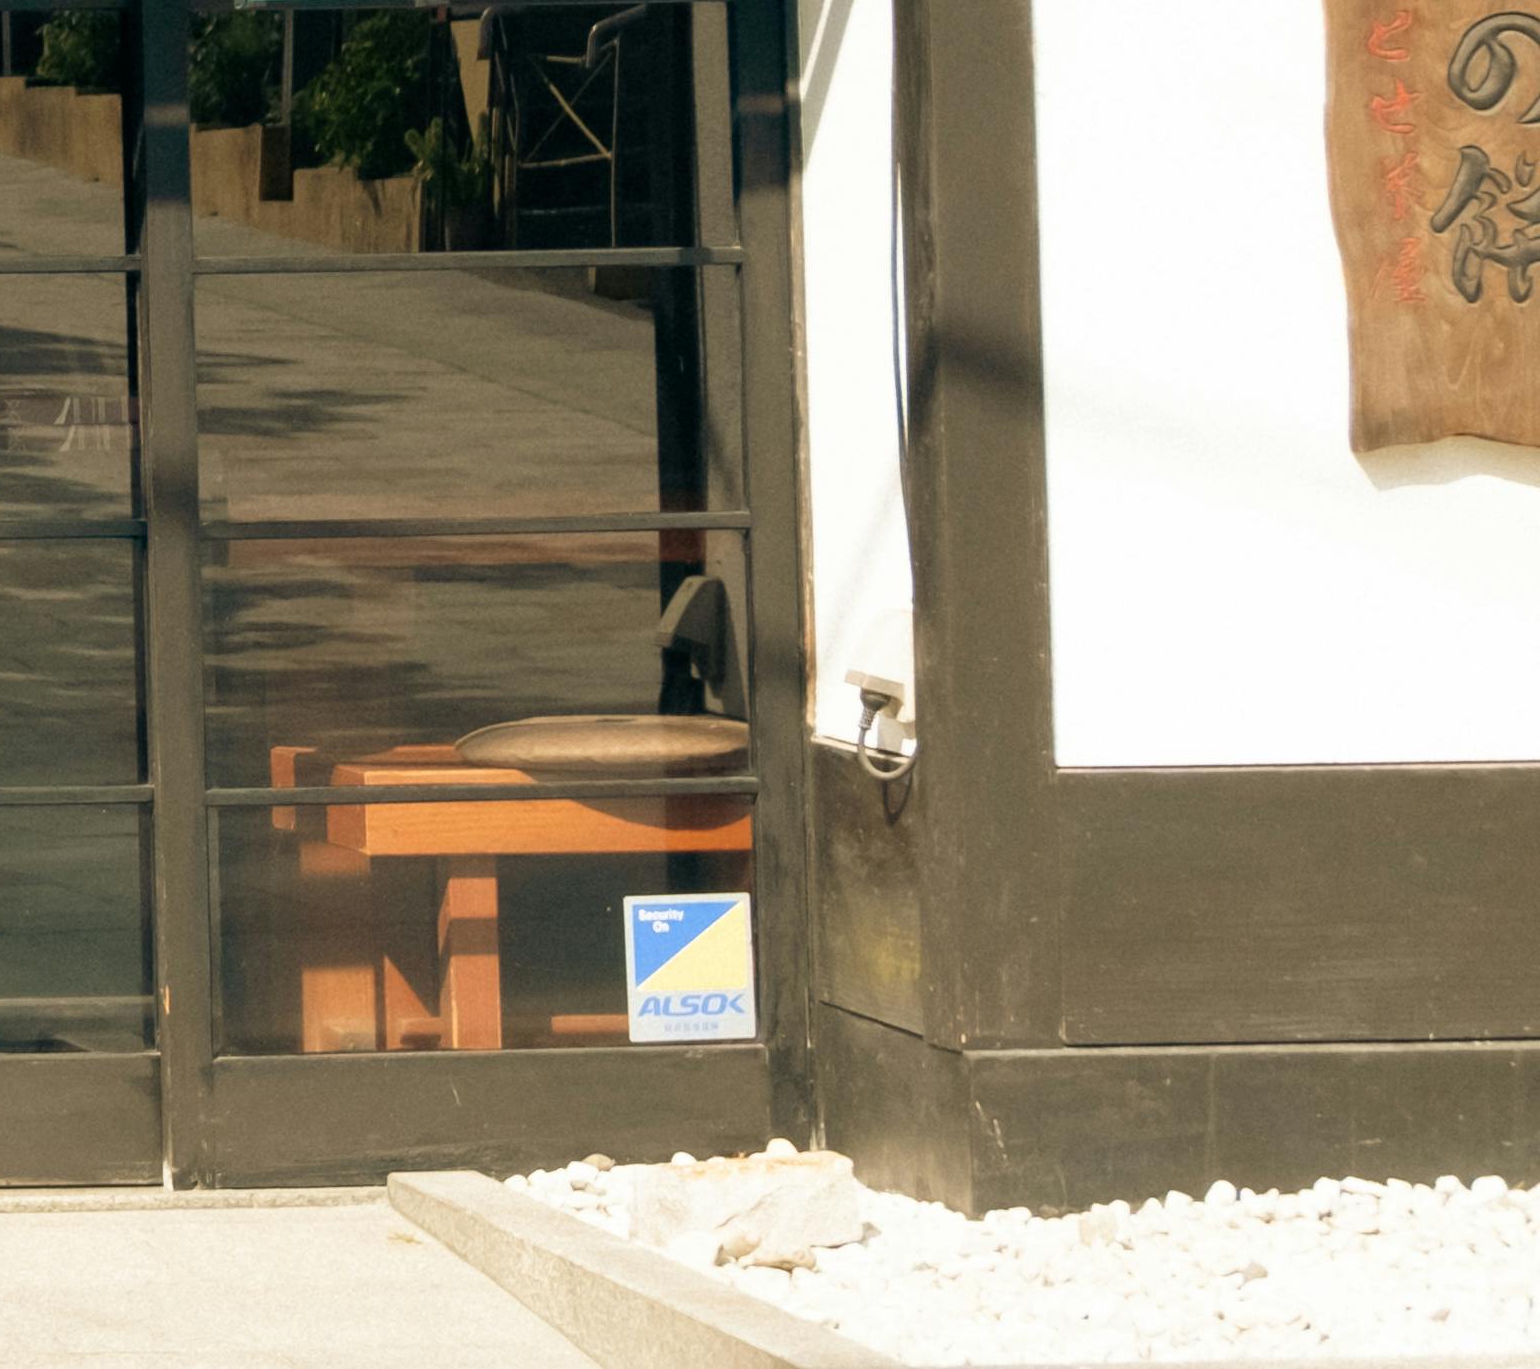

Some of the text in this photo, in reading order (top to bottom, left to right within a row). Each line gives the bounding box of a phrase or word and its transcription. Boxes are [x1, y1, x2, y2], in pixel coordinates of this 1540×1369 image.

[637, 908, 685, 923] Security
[652, 920, 670, 934] On
[637, 992, 747, 1018] ALSOK
